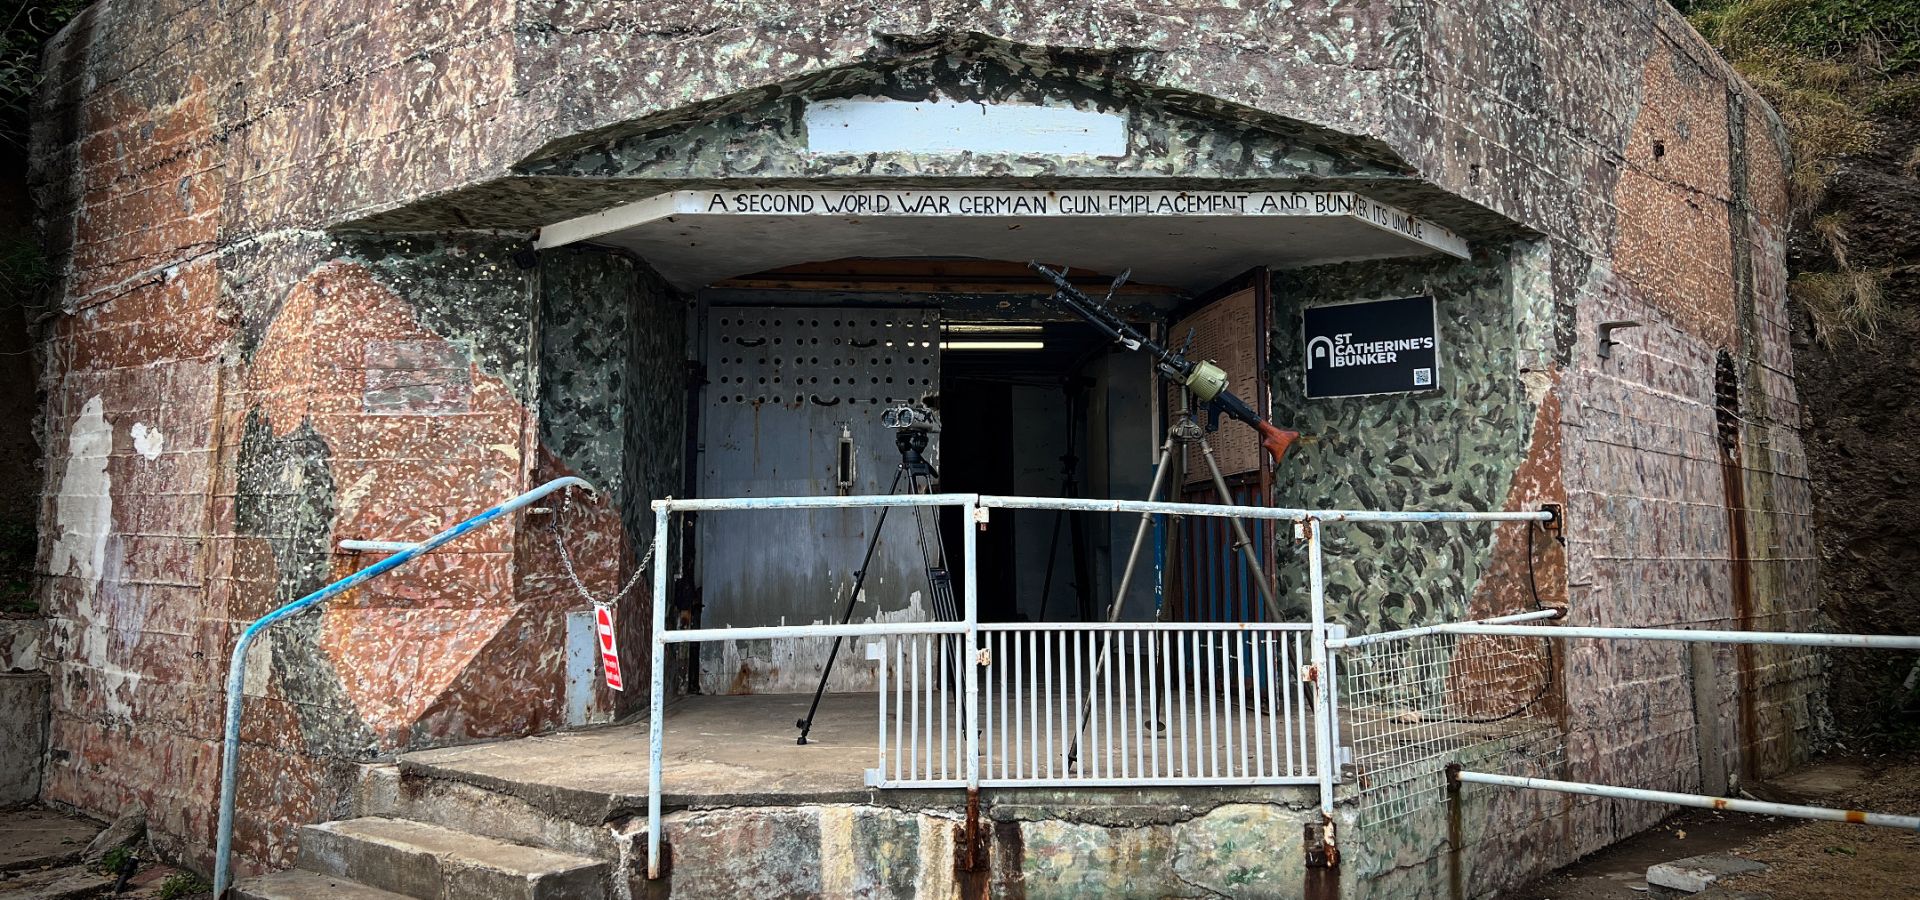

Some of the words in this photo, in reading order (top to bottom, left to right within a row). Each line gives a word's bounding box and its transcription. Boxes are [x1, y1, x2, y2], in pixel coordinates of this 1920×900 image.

[707, 193, 729, 212] A
[736, 194, 814, 213] SECOND
[821, 194, 890, 213] WORLD
[897, 194, 952, 213] WAR
[959, 195, 1047, 214] GERMAN
[1059, 195, 1100, 214] GUN
[1108, 195, 1248, 213] EMPLACEMENT
[1260, 195, 1308, 213] AND
[1315, 193, 1370, 220] BUNKER
[1373, 203, 1388, 226] ITS
[1392, 212, 1423, 240] UNIQUE
[1334, 333, 1353, 345] ST
[1335, 337, 1434, 356] CATHERINE'S
[1335, 352, 1397, 367] BUNKER
